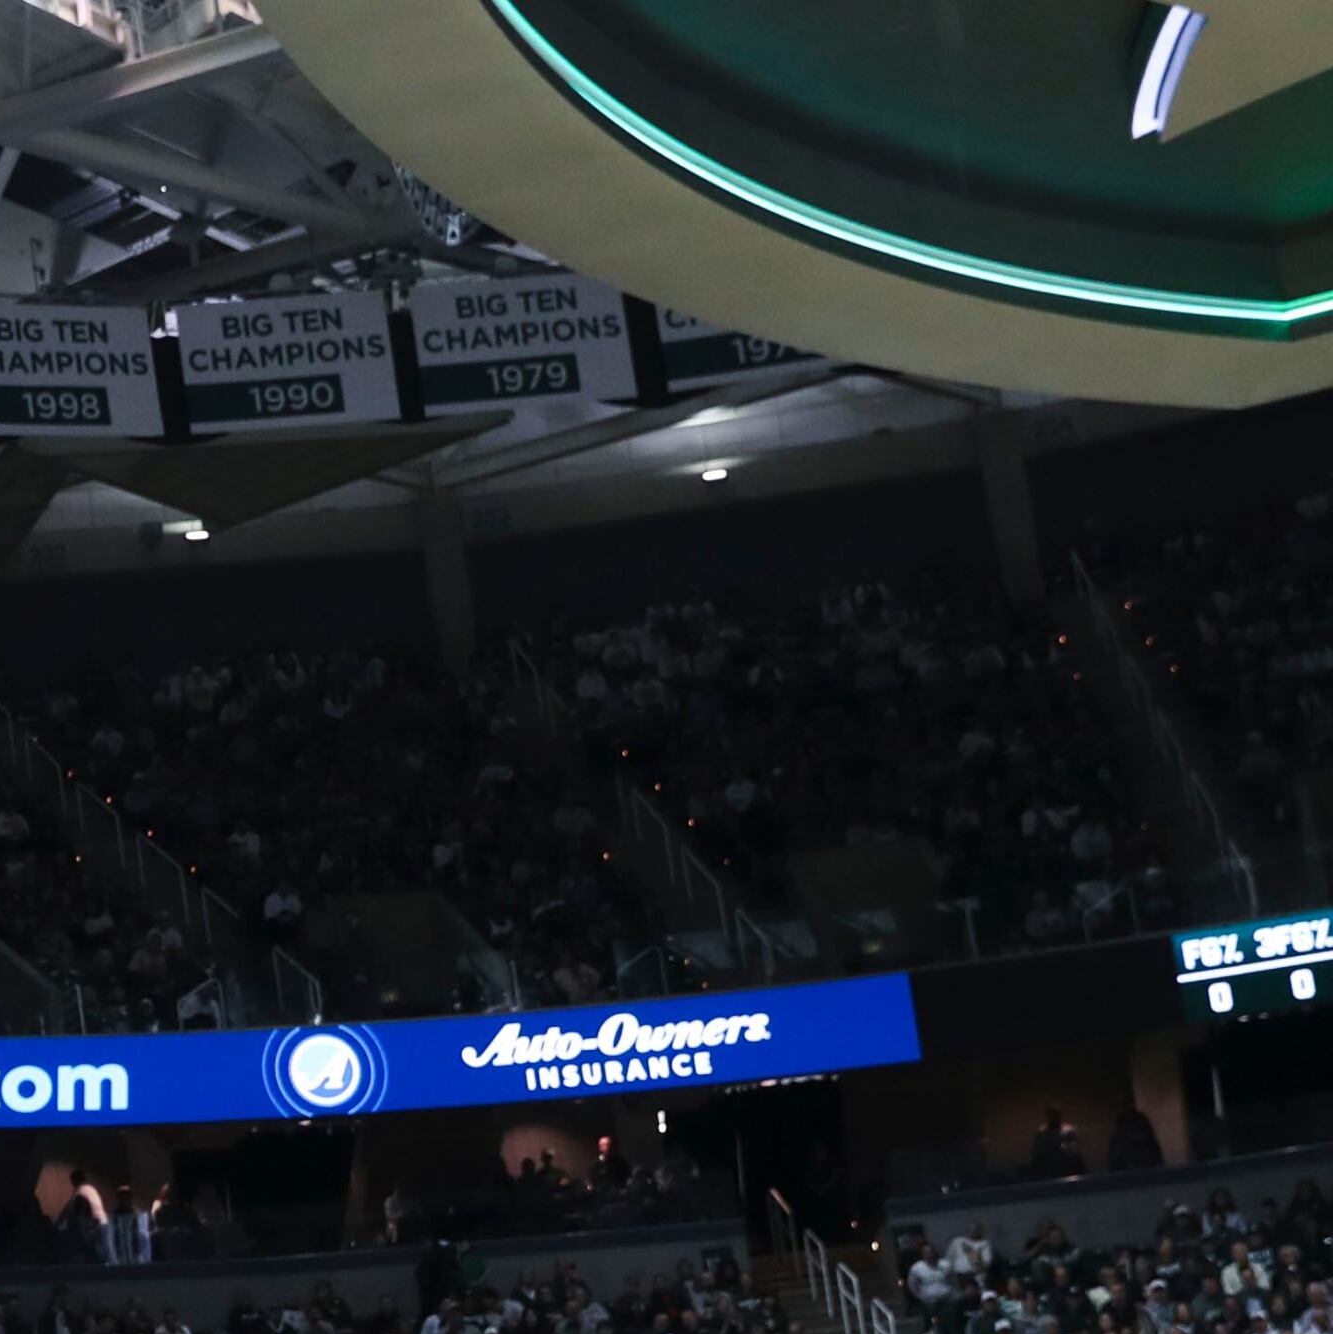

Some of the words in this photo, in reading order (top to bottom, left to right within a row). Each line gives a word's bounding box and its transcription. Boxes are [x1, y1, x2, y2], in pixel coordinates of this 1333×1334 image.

[455, 293, 508, 320] BIG
[520, 288, 577, 314] TEN
[53, 319, 109, 344] TEN
[221, 314, 273, 340] BIG
[282, 308, 343, 334] TEN
[422, 316, 622, 354] CHAMPIONS
[188, 335, 386, 373] CHAMPIONS
[485, 360, 568, 394] 1979
[21, 390, 101, 420] 1998
[247, 380, 334, 413] 1990
[1208, 981, 1234, 1014] 0
[1289, 968, 1317, 1000] 0
[526, 1051, 713, 1091] INSURANCE
